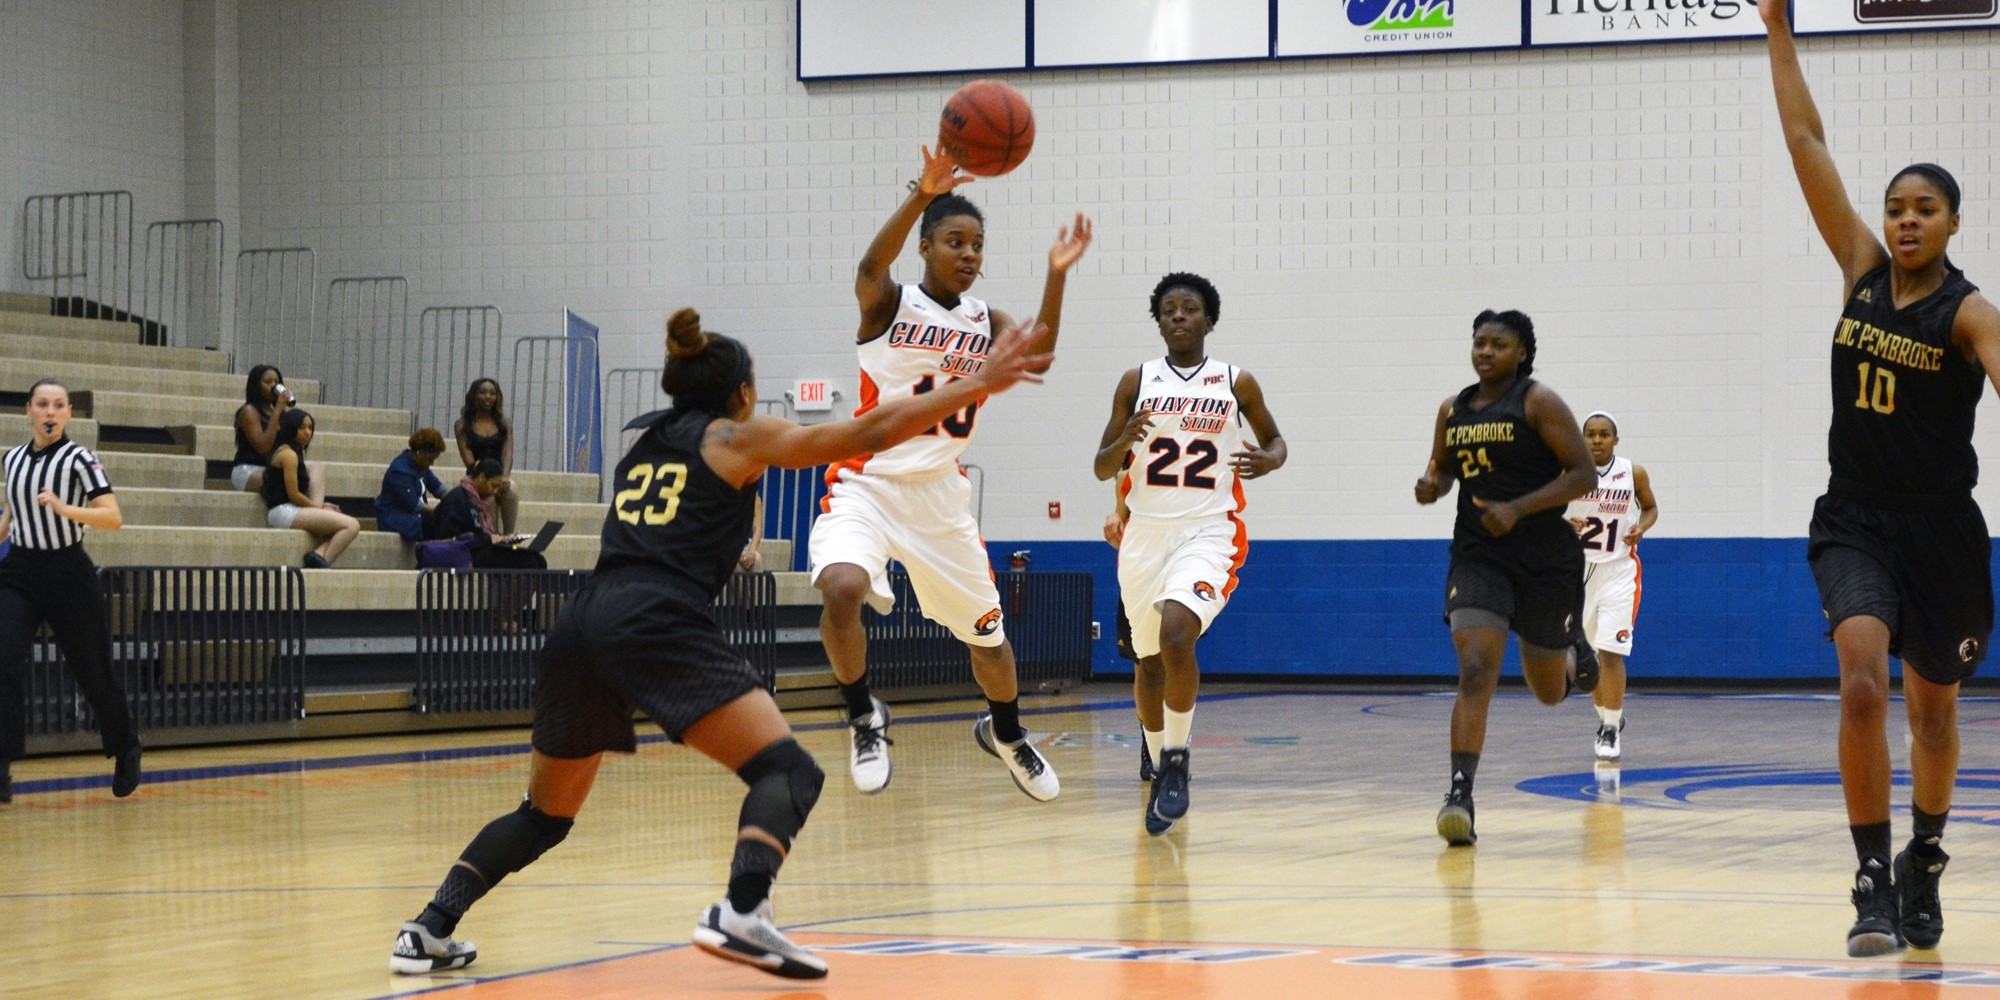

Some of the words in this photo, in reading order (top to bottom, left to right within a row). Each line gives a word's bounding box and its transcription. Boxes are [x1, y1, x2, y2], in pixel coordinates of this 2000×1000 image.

[1602, 11, 1699, 30] BANK
[1364, 33, 1410, 42] CREDIT
[1415, 31, 1453, 40] UNION
[1857, 323, 1944, 371] PEMBROKE
[940, 354, 987, 377] STAT
[1203, 374, 1225, 386] PBC
[1855, 361, 1896, 415] 10
[800, 382, 825, 402] EXIT
[1140, 396, 1233, 419] CLAYTON
[1180, 416, 1226, 434] STATE
[1456, 422, 1514, 445] PEMBROKE
[1146, 436, 1219, 491] 22
[1457, 446, 1494, 479] 24
[615, 463, 688, 526] 23
[1580, 488, 1632, 504] AYTON
[1580, 516, 1620, 553] 21
